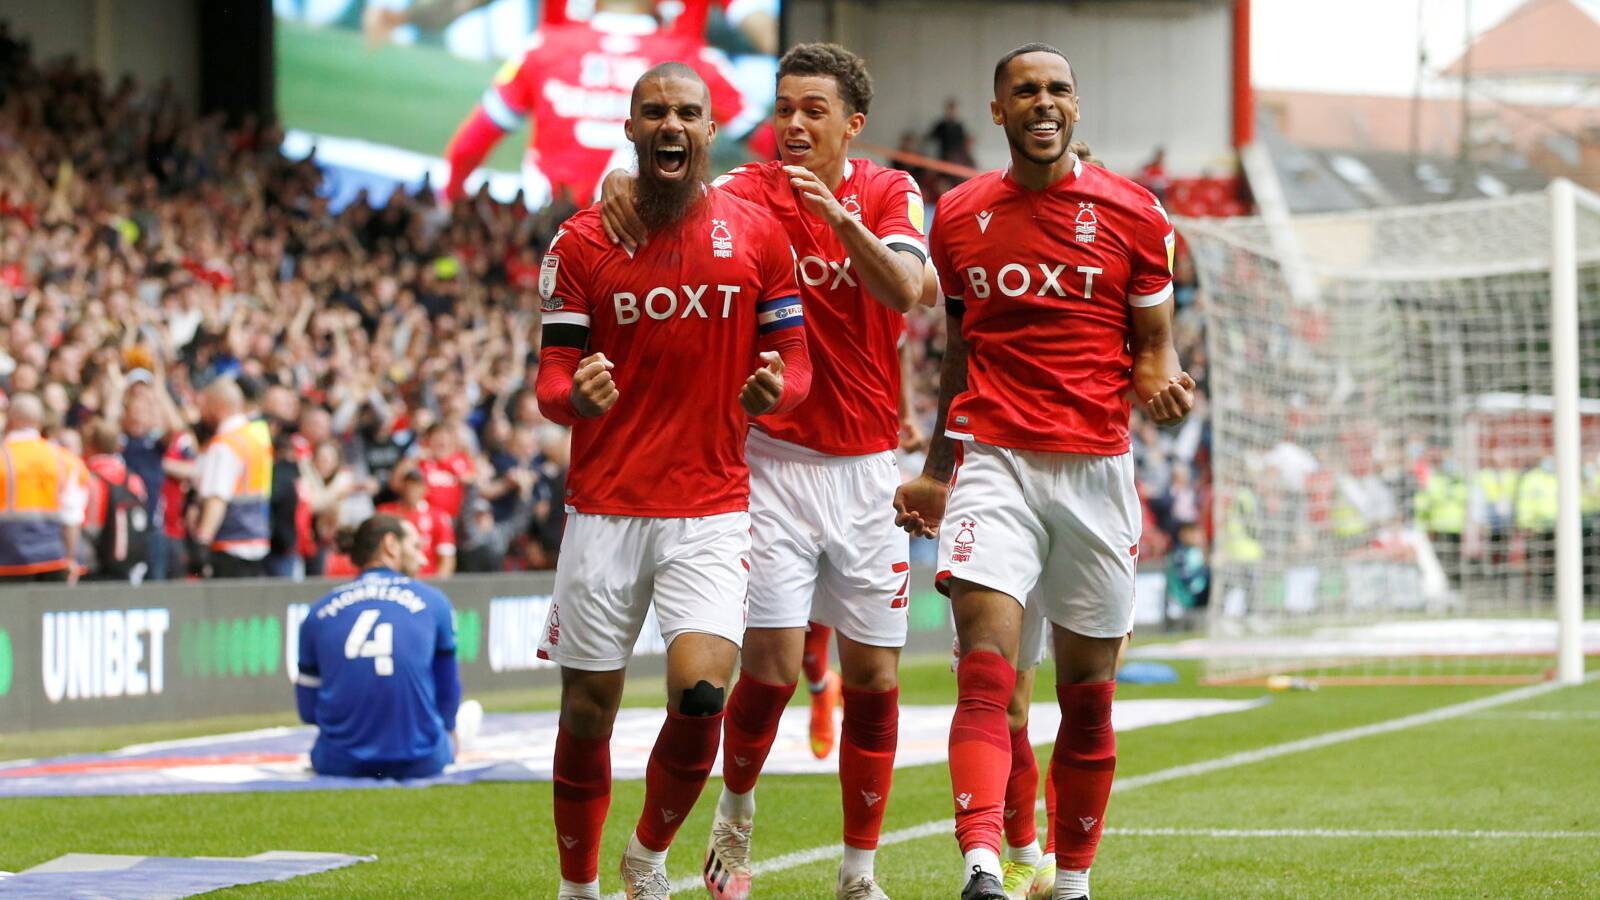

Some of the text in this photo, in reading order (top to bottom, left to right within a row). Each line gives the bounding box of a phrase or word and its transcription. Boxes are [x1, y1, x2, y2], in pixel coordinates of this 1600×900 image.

[799, 255, 858, 291] OX
[967, 262, 1103, 299] BOXT
[613, 284, 741, 326] BOXT
[41, 607, 170, 703] UNIBET
[344, 608, 395, 677] 4
